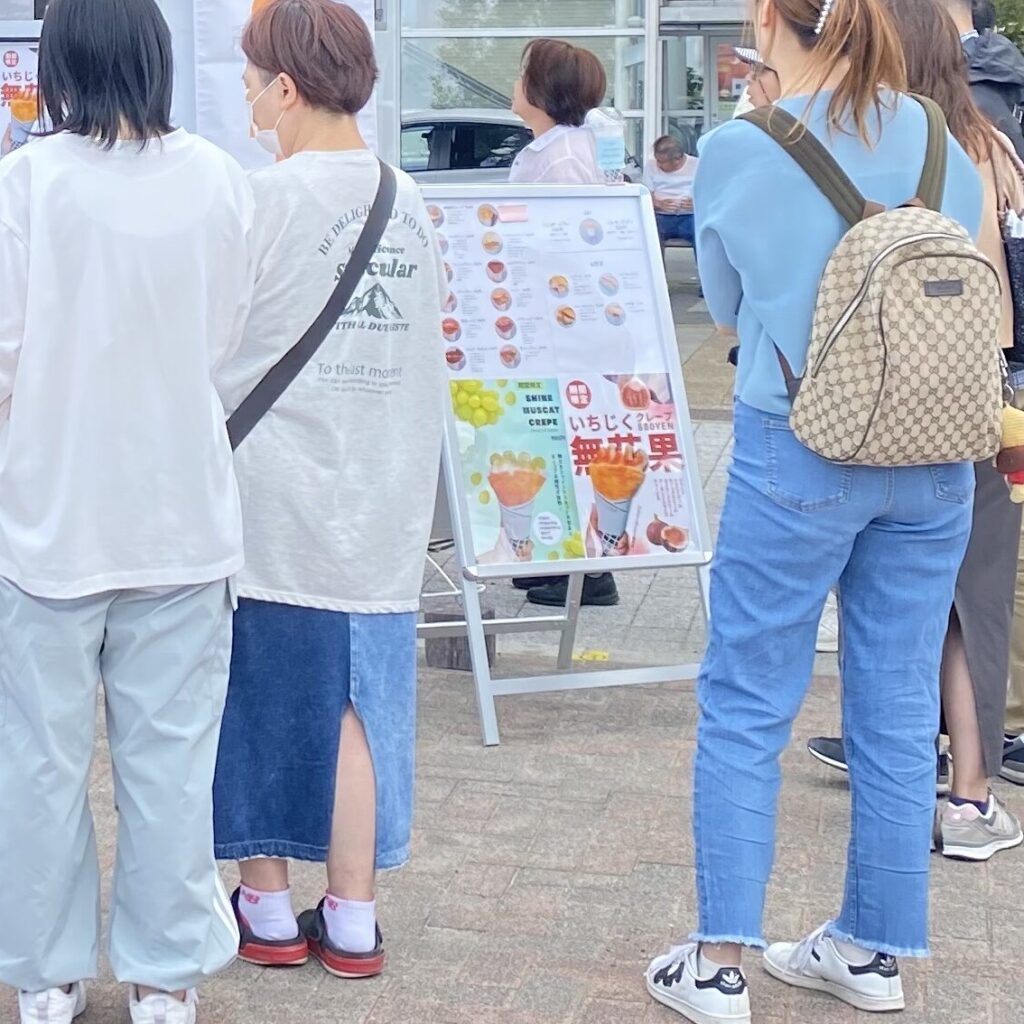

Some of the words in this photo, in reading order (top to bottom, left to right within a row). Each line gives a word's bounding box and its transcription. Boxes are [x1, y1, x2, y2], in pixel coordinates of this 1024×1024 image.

[2, 70, 38, 82] いちじ
[331, 204, 399, 237] DELIGHD
[317, 363, 332, 375] To
[528, 418, 558, 426] CREPE
[569, 413, 633, 432] いちじく
